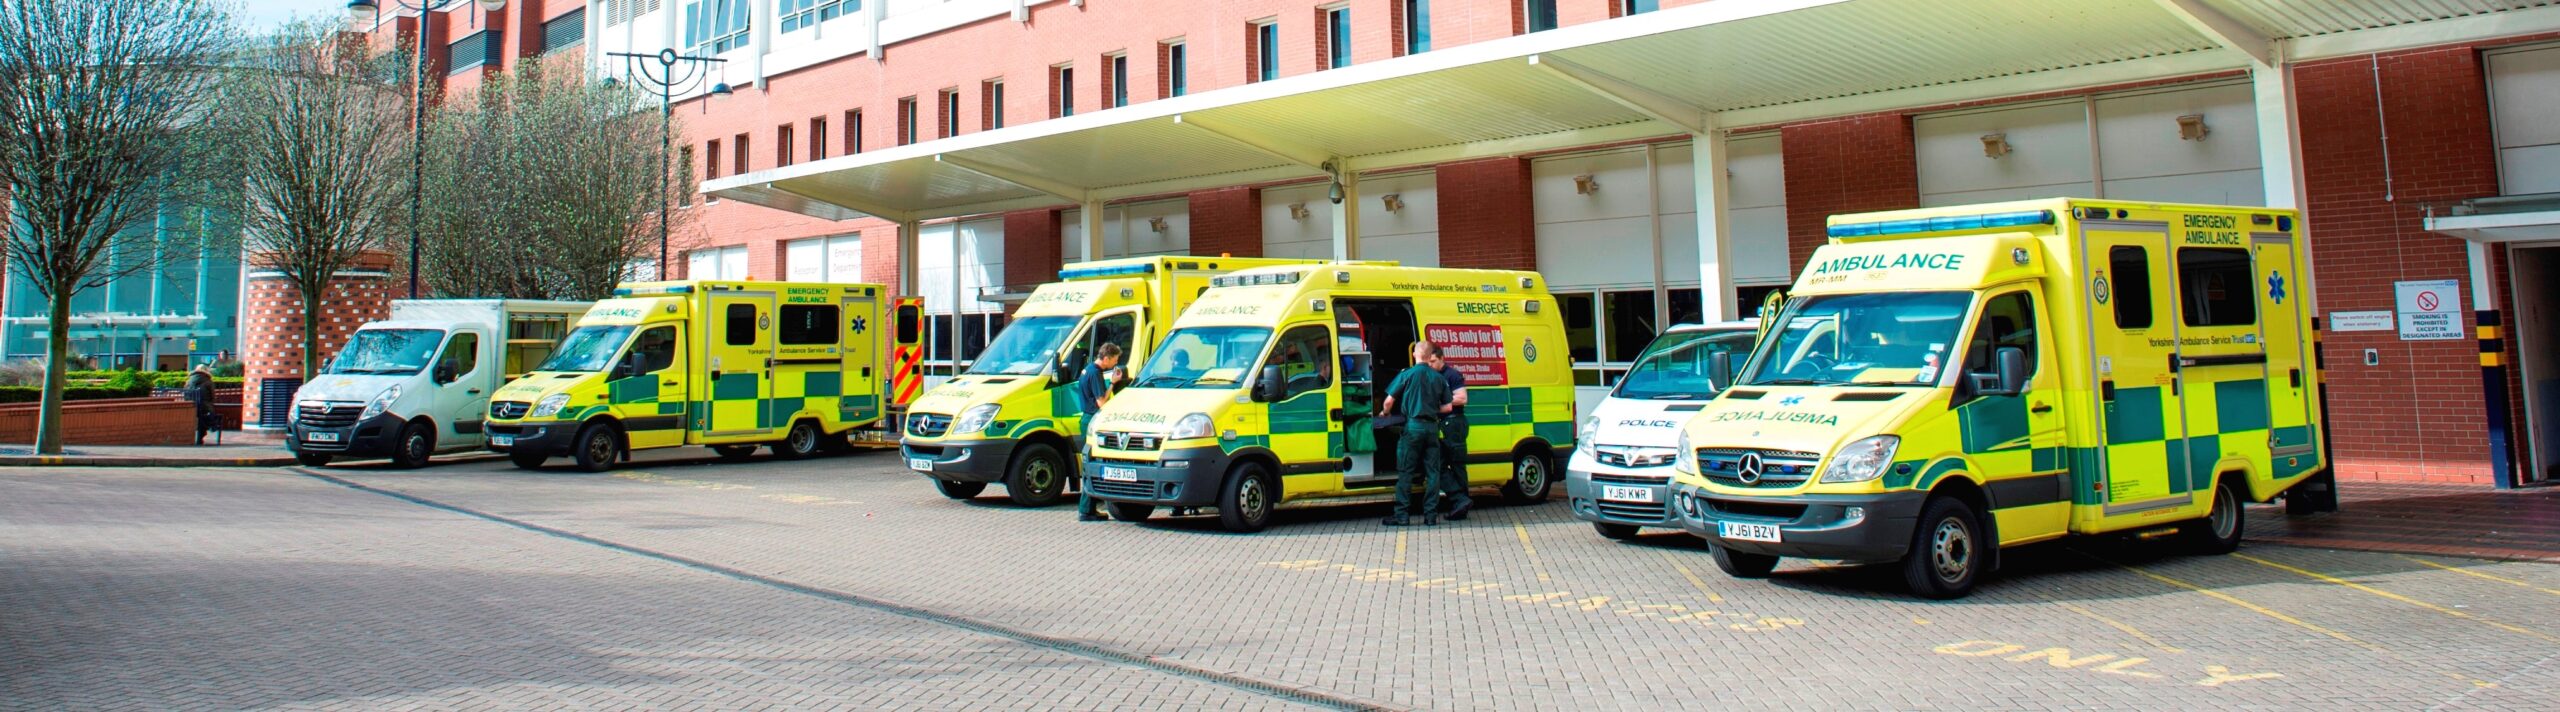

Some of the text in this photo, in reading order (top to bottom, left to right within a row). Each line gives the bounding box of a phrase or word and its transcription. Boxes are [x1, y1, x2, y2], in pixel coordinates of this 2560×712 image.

[2183, 214, 2236, 229] EMERGENCY
[2185, 230, 2239, 245] AMBULANCE
[1813, 253, 1965, 275] AMBULANCE
[1391, 282, 1419, 291] Yorkshire
[1421, 283, 1453, 291] Ambulance
[1455, 283, 1477, 292] Service
[1457, 302, 1510, 314] EMERGECE
[1430, 329, 1503, 344] 999 is only for lif
[2148, 337, 2175, 347] Yorkshire
[2179, 336, 2209, 346] Ambulance
[2211, 336, 2231, 345] Service
[2231, 334, 2244, 344] Trust
[1443, 345, 1480, 358] nditions
[1480, 345, 1497, 358] and
[1619, 419, 1678, 428] POLICE
[1105, 467, 1122, 479] YJ58
[1608, 488, 1647, 500] YJ61 KWR
[1727, 524, 1775, 539] YJ61 BZV
